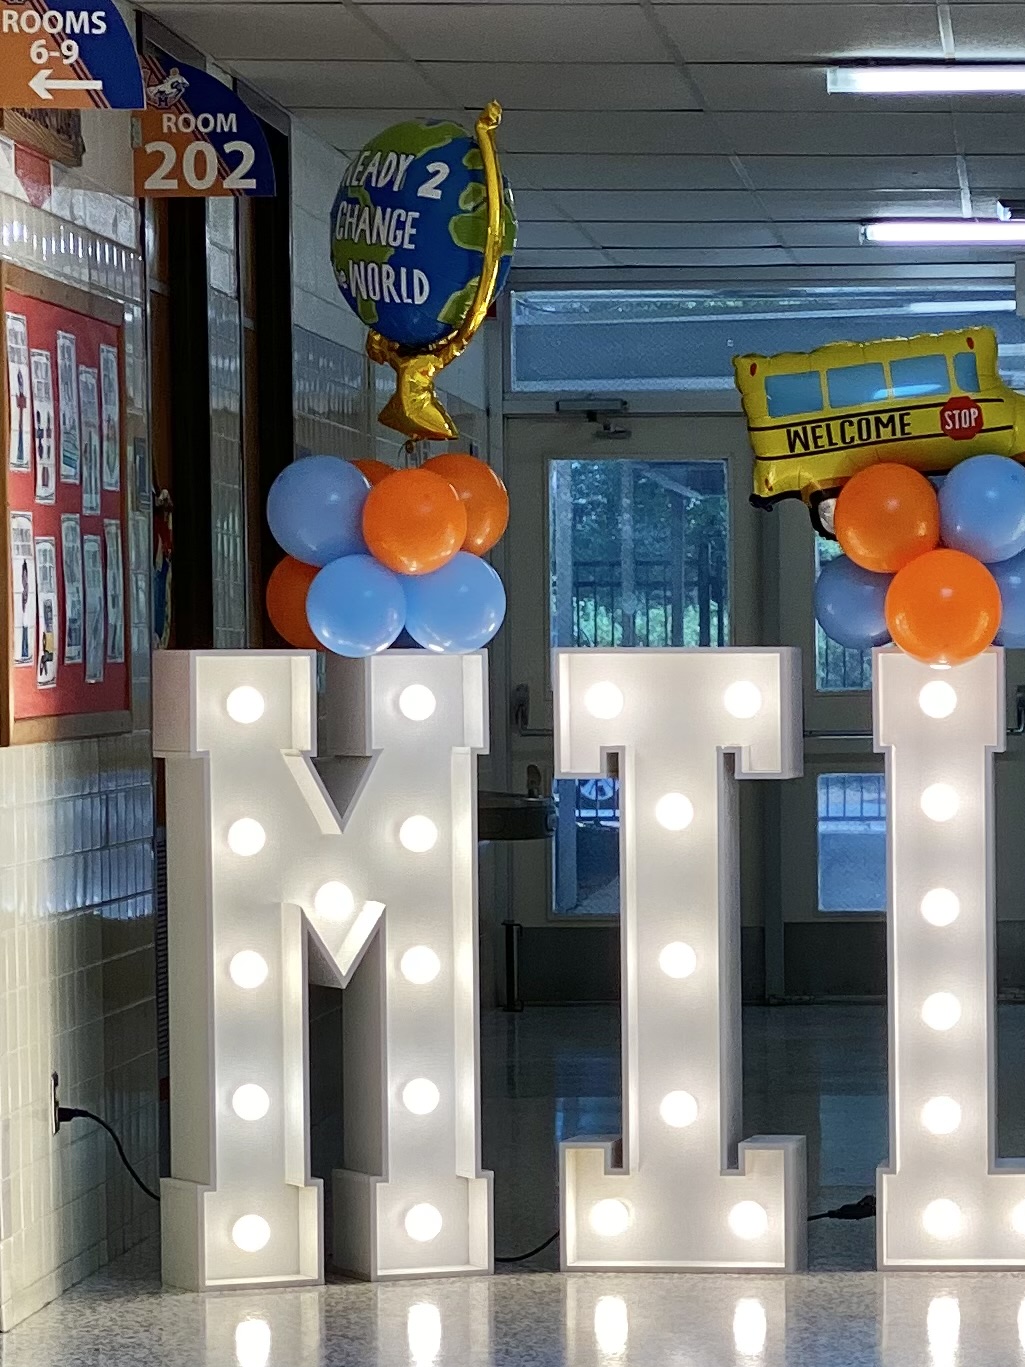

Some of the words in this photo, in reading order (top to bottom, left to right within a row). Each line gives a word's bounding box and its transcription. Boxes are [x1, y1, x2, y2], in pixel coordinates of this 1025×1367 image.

[2, 9, 108, 35] ROOMS
[30, 39, 79, 65] 6-9
[162, 112, 238, 134] ROOM
[144, 140, 257, 190] 202
[416, 161, 450, 200] 2
[335, 200, 420, 250] CHANGE
[348, 259, 430, 305] WORLD
[785, 412, 913, 454] WELCOME
[943, 408, 980, 431] STOP
